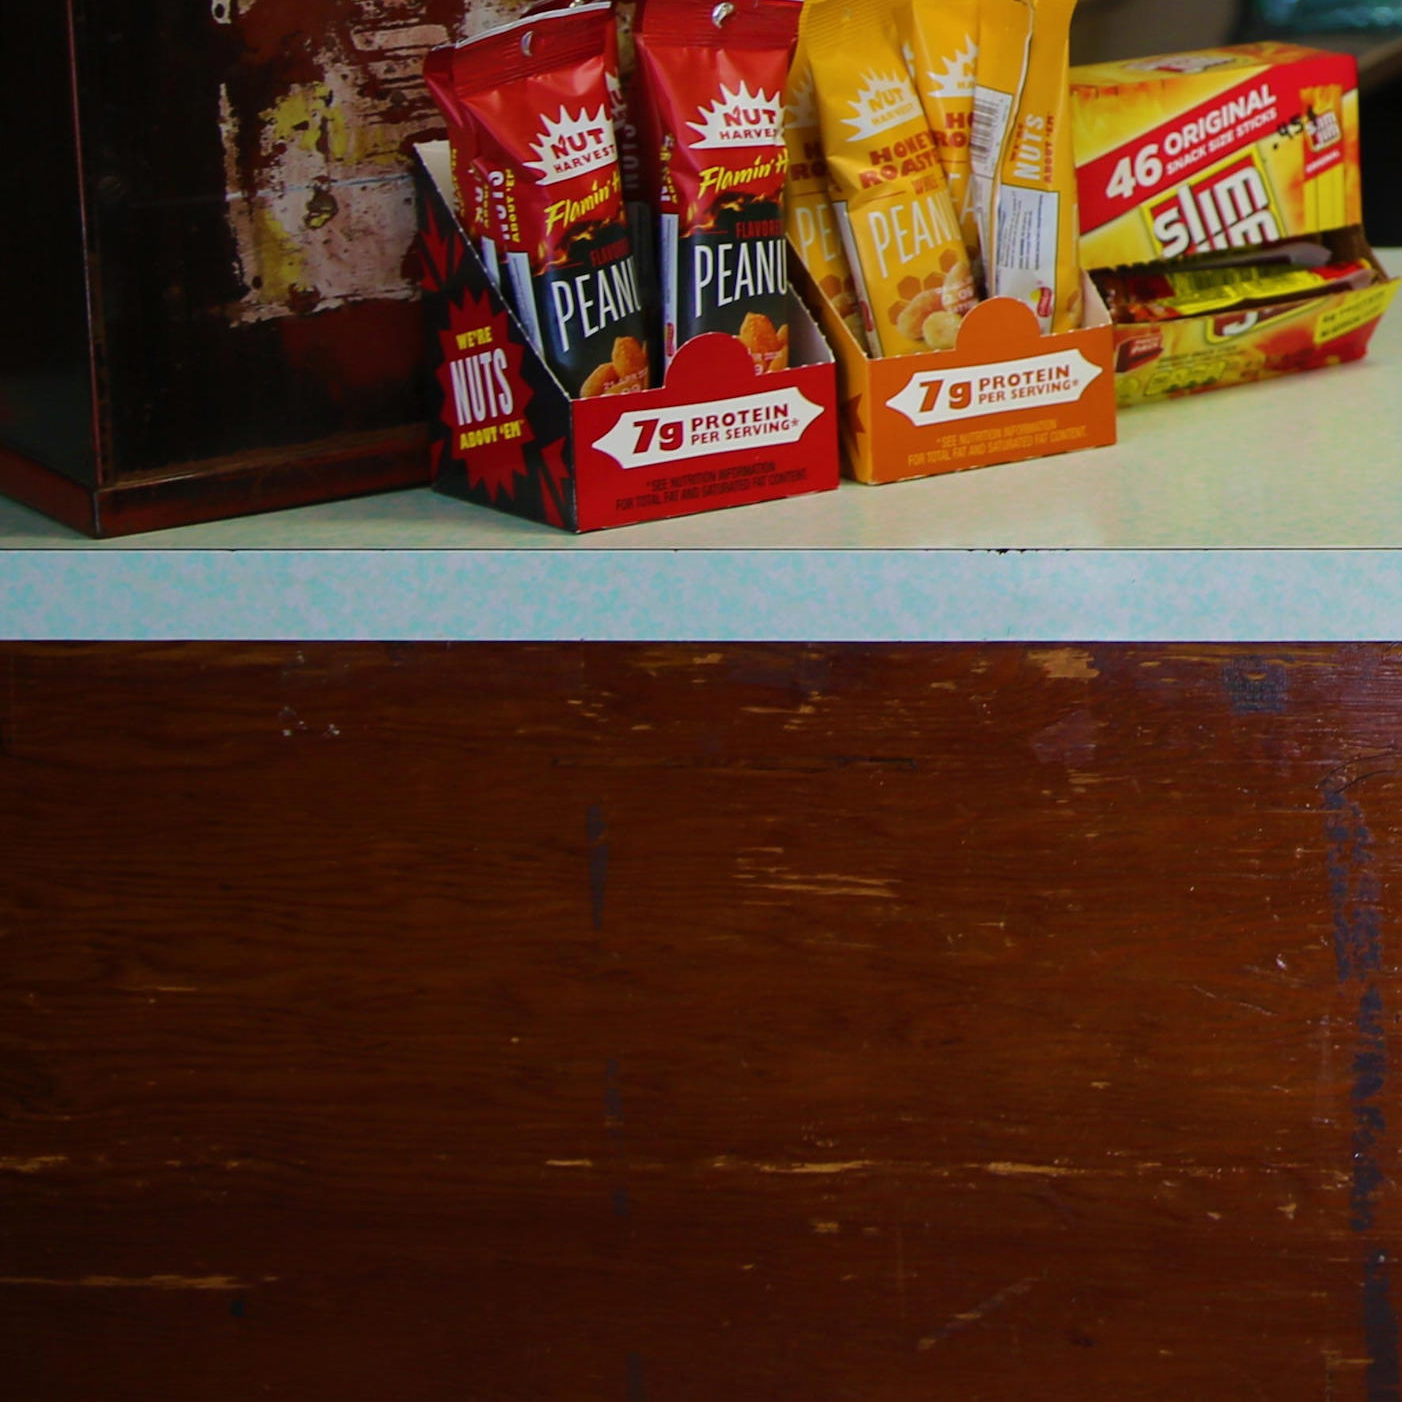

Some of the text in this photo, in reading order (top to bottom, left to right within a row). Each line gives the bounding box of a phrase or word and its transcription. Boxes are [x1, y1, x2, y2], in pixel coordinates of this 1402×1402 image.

[724, 107, 777, 126] NUT
[551, 128, 605, 159] NUT
[719, 128, 778, 141] HARVE
[1013, 114, 1045, 180] NUTS
[1106, 84, 1277, 199] 46 ORIGINAL
[1165, 108, 1277, 175] SNACK SIZE STICKS
[553, 144, 616, 172] HARVEST
[867, 190, 961, 279] PEAN
[694, 239, 787, 317] PEANU
[552, 256, 640, 352] PEAN
[456, 326, 493, 351] WE'RE
[450, 348, 514, 426] NUTS
[978, 365, 1069, 392] PROTEIN
[918, 379, 972, 413] 7g
[978, 391, 1006, 405] PER
[691, 403, 789, 432] PROTEIN
[460, 426, 498, 450] ABOUT
[632, 418, 684, 455] 7g
[691, 428, 720, 446] PER
